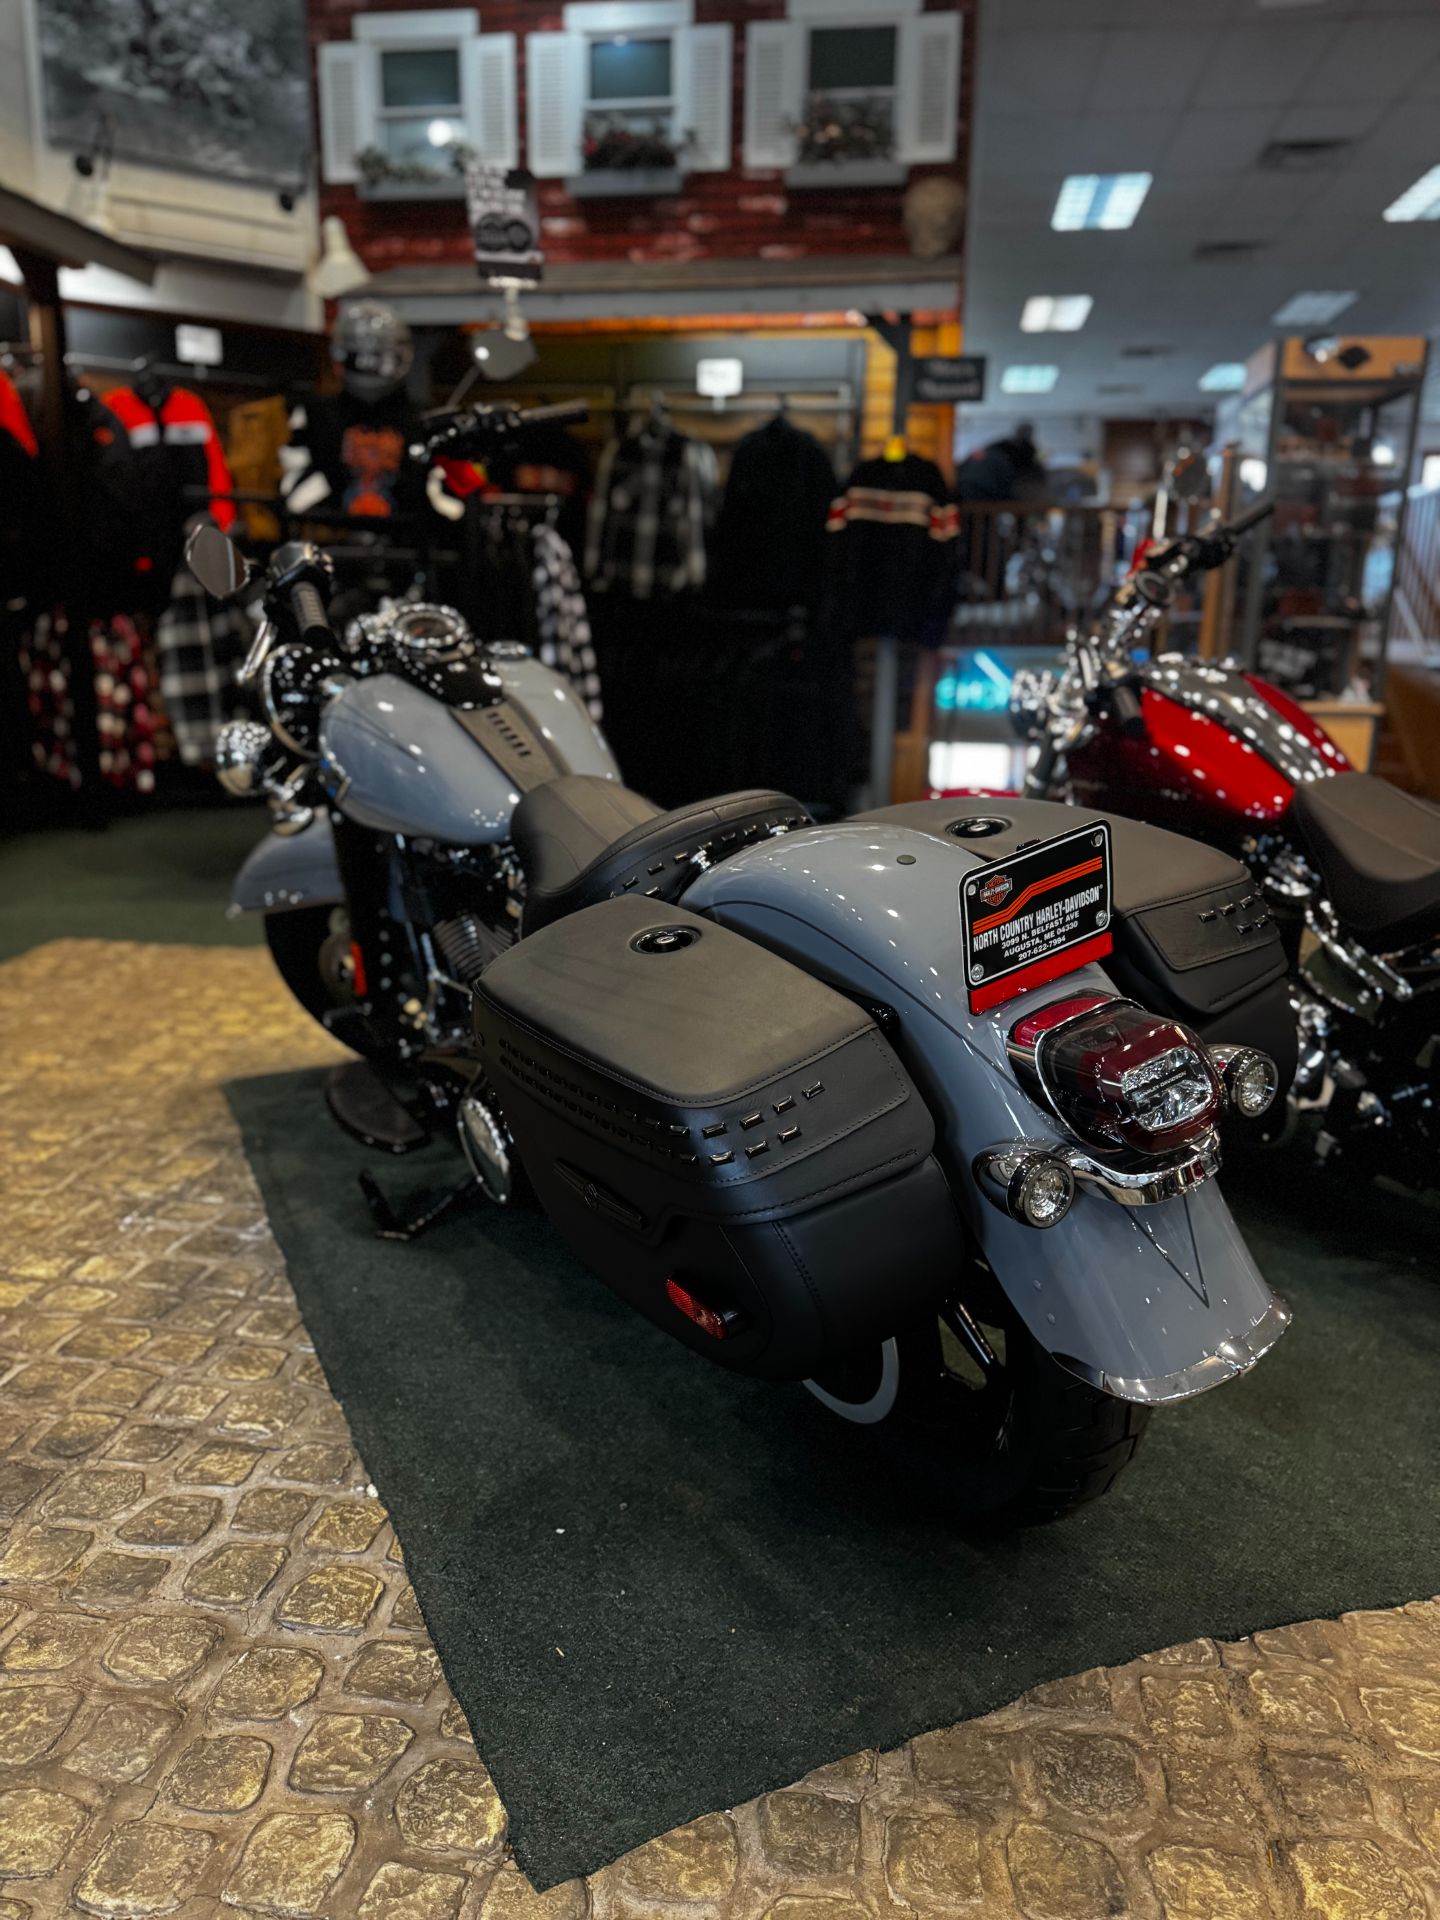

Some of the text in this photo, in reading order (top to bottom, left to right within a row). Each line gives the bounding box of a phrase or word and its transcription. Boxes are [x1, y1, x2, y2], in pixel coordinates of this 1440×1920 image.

[973, 930, 998, 952] NORTH
[1000, 913, 1034, 941] COUNTRY
[1001, 911, 1080, 950] 3099 N. BELFAST AVE
[1003, 920, 1079, 958] AUGUSTA, ME 04330
[1018, 935, 1067, 961] 207-622-7994
